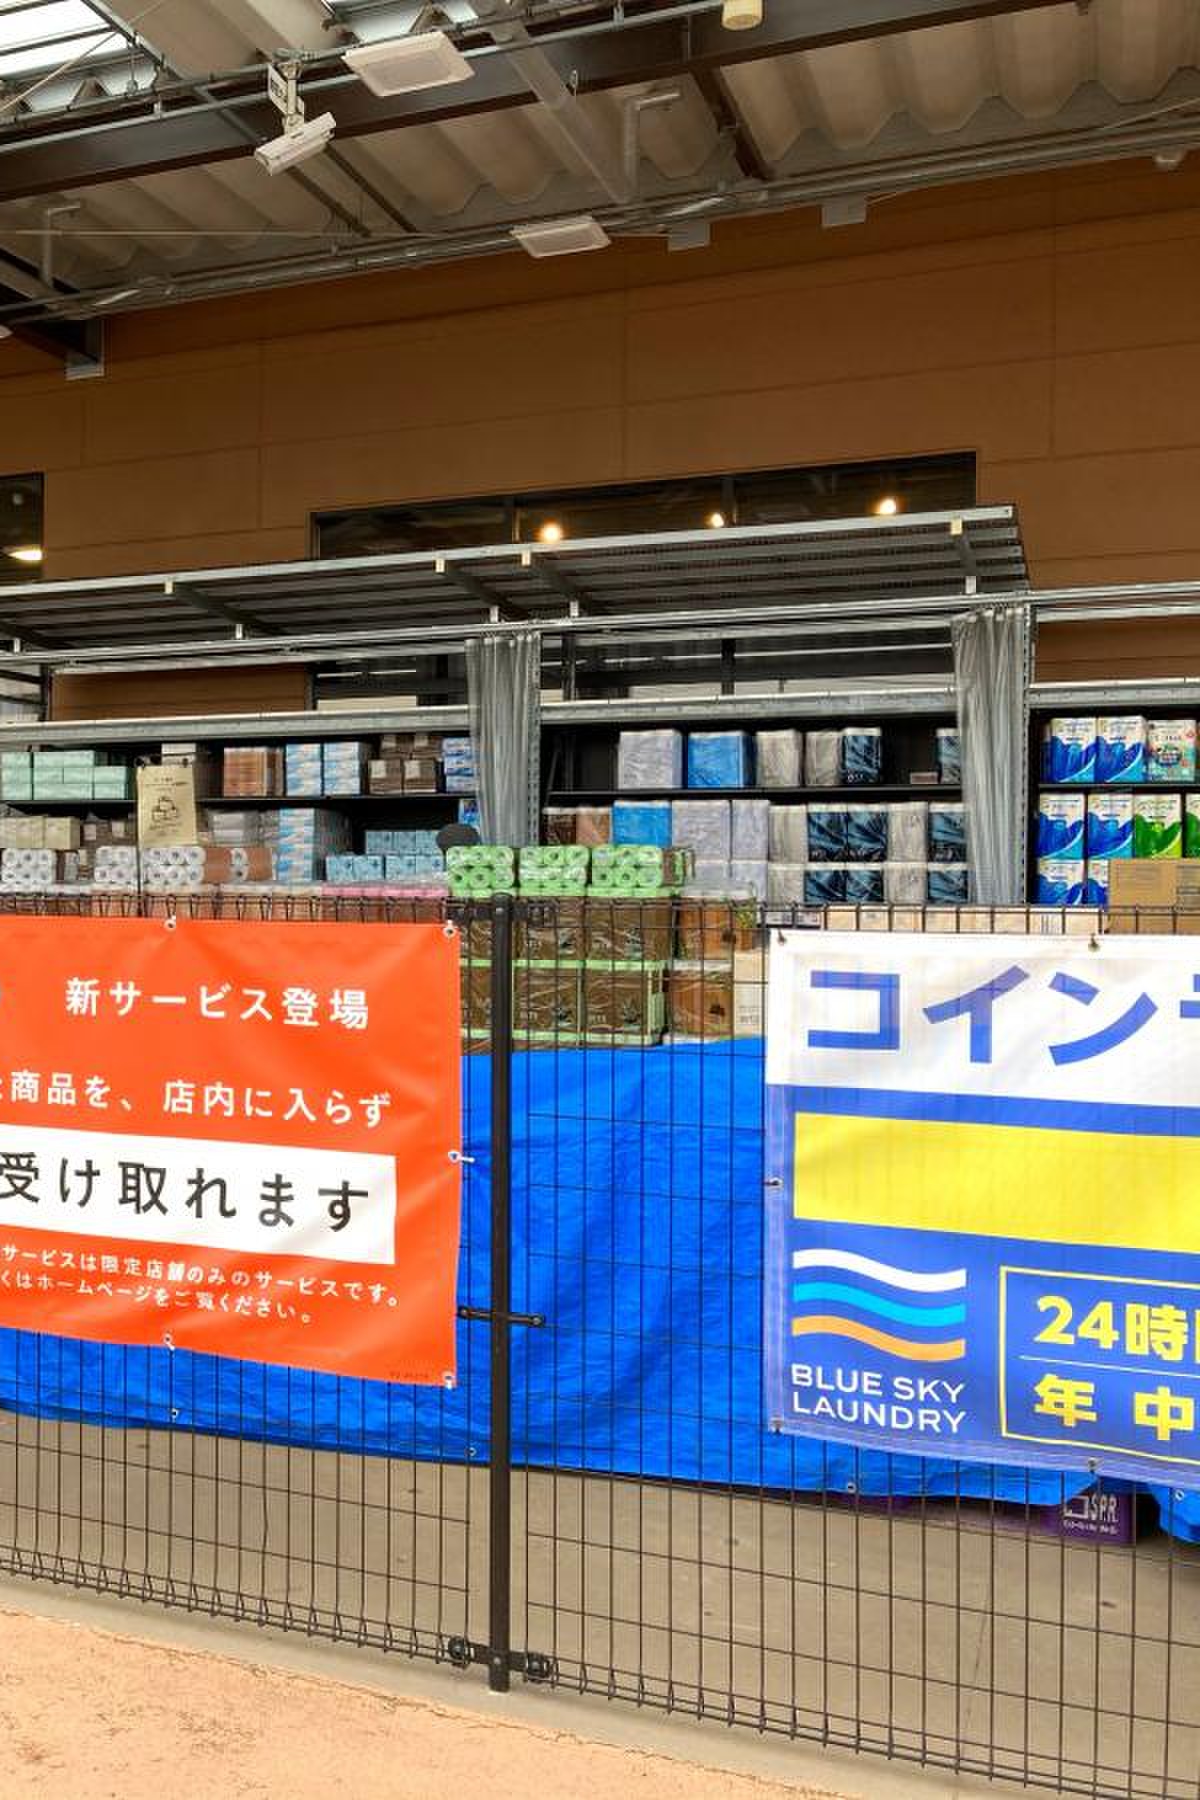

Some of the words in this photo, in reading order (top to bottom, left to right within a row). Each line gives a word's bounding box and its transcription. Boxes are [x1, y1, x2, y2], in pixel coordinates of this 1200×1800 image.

[65, 977, 369, 1029] 新サービス登場
[807, 965, 1200, 1067] コイン
[1033, 1294, 1200, 1364] 24時
[791, 1363, 883, 1396] BLUE
[893, 1376, 966, 1404] SKY
[793, 1391, 966, 1433] LAUNDRY
